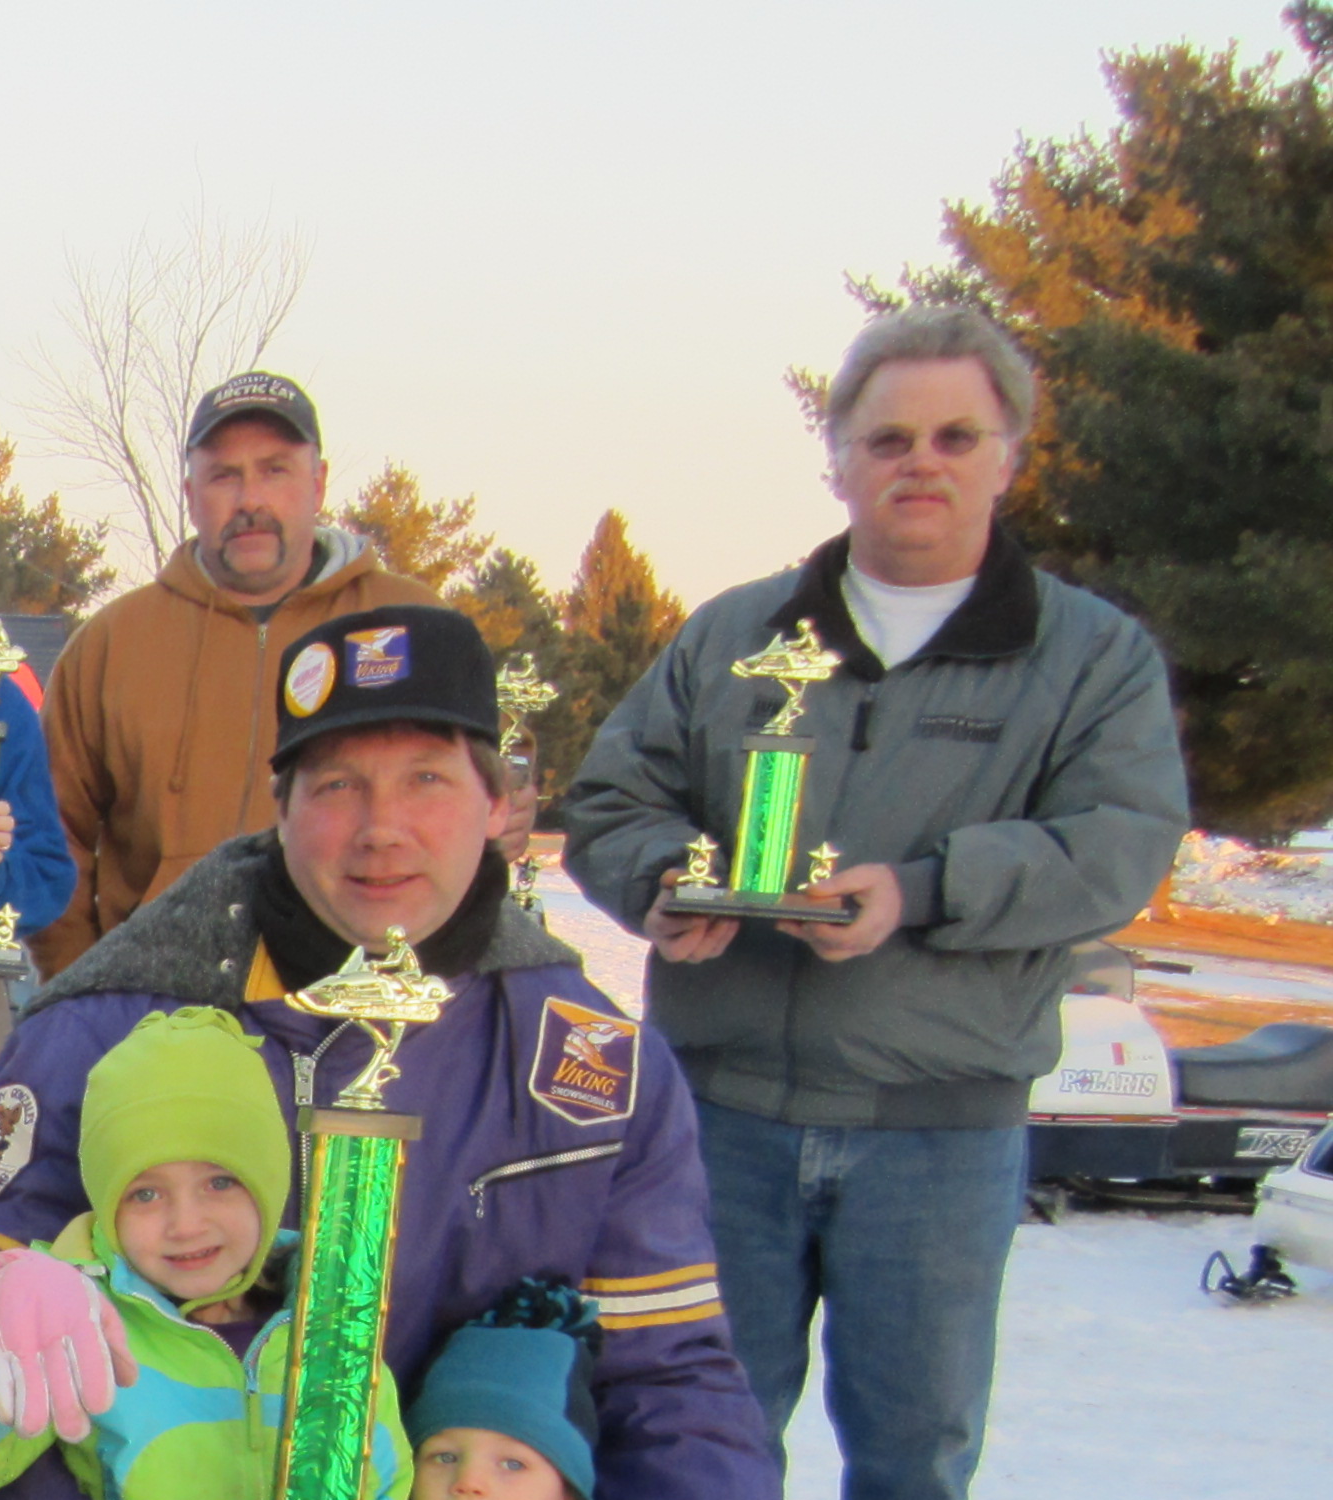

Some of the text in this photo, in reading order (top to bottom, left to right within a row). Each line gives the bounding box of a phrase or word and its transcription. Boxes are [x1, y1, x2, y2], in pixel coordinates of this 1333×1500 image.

[553, 1057, 618, 1096] VIKING
[1060, 1069, 1158, 1098] POLARIS
[551, 1085, 616, 1111] SNOWMOBILES
